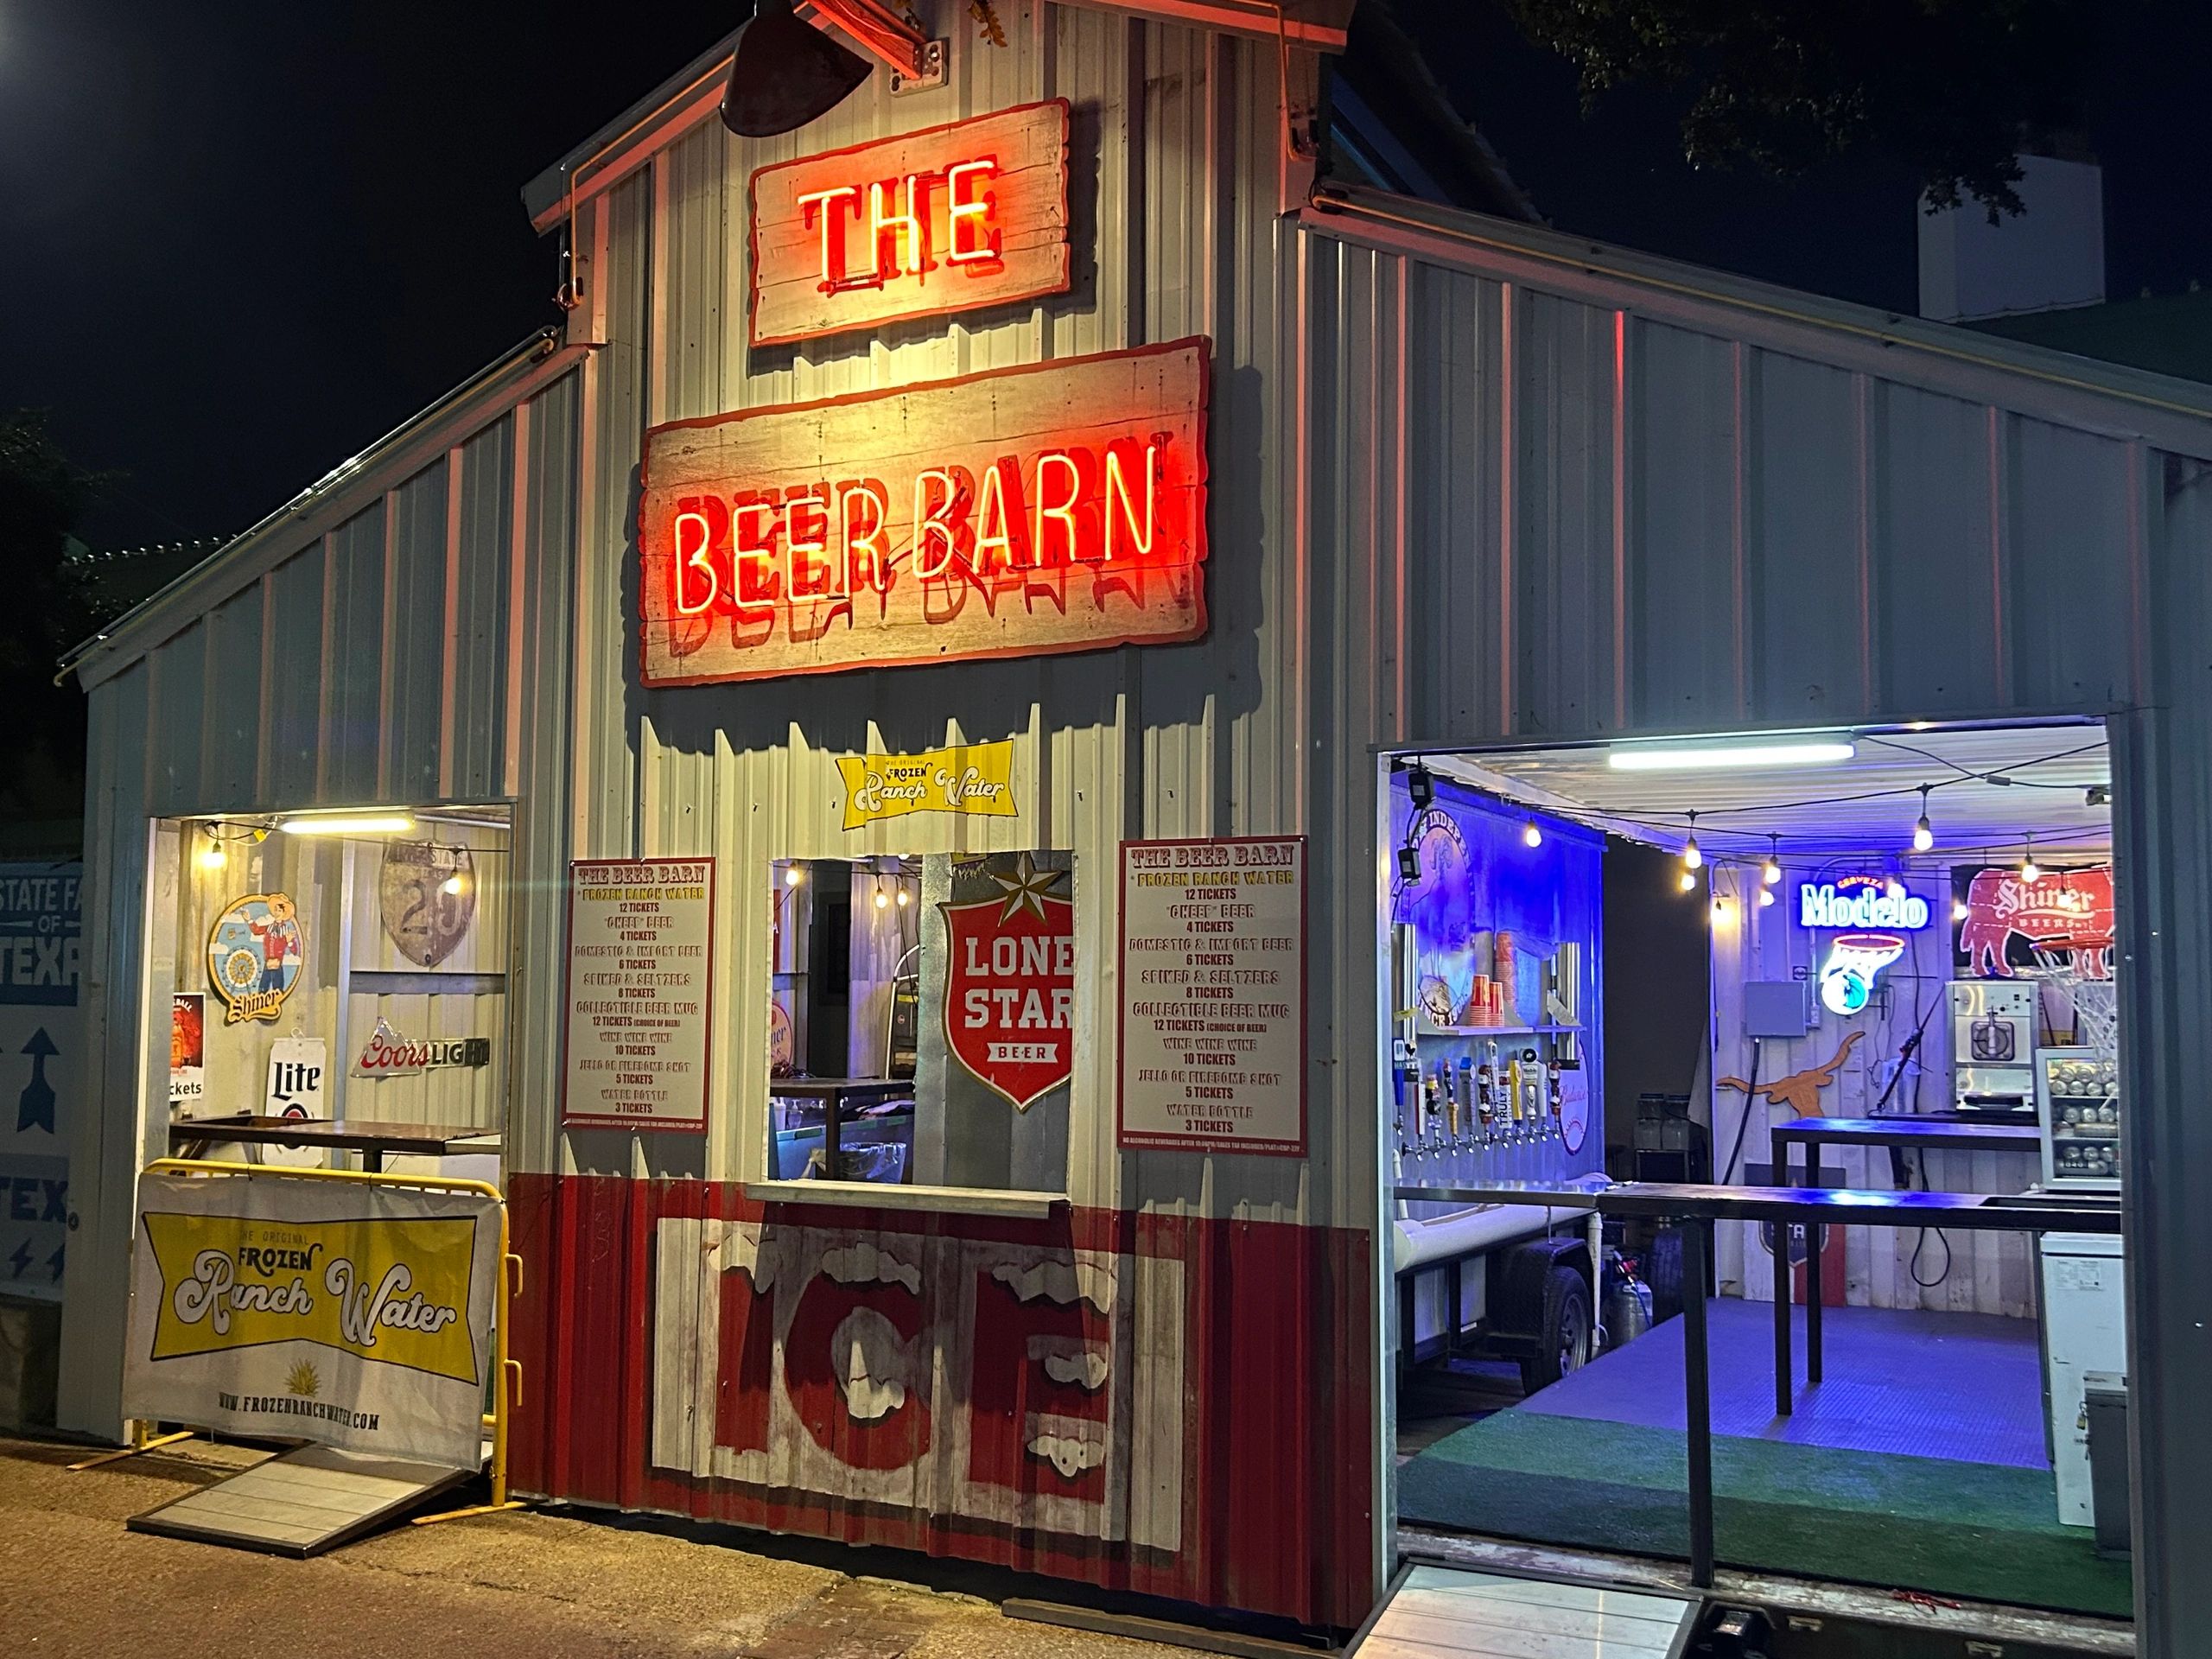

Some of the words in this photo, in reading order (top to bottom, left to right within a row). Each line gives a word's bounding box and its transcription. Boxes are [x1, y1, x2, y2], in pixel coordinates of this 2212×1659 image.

[798, 154, 1001, 283] THE
[671, 480, 888, 615] BEER
[911, 432, 1173, 579] BARN
[887, 761, 933, 782] FROZEN
[854, 770, 928, 812] Ranch
[934, 766, 1005, 806] Water
[1131, 849, 1170, 868] THE
[1175, 846, 1230, 868] BEER
[1234, 844, 1294, 866] BARN
[578, 868, 608, 885] THE
[612, 866, 655, 884] BEER
[658, 865, 705, 883] BARN
[1138, 873, 1189, 887] FROZEN
[1192, 871, 1240, 886] RANCH
[1243, 871, 1294, 885] WATER
[1837, 875, 1884, 889] CERVEZA
[582, 888, 622, 900] FROZEN
[626, 888, 662, 900] RANCH
[665, 887, 704, 899] WATER
[1185, 890, 1195, 900] 12
[1198, 888, 1236, 899] TICKETS
[1995, 879, 2095, 918] Shiner
[401, 876, 464, 937] 20
[619, 903, 627, 912] 12
[629, 902, 659, 912] TICKETS
[1221, 905, 1255, 918] BEER
[1801, 883, 1928, 929] Modelo
[38, 915, 60, 932] OF
[646, 916, 674, 928] BEER
[1186, 922, 1192, 933] 4
[1195, 921, 1234, 933] TICKETS
[620, 931, 625, 941] 4
[626, 931, 657, 941] TICKETS
[1129, 938, 1192, 950] DOMESTIC
[1195, 939, 1205, 950] &
[1210, 938, 1258, 950] IMPORT
[1262, 938, 1294, 950] BEER
[575, 945, 624, 957] DOMESTIC
[626, 946, 634, 957] &
[637, 945, 675, 957] IMPORT
[677, 945, 703, 957] BEER
[965, 936, 1073, 976] LONE
[619, 960, 624, 969] 6
[626, 959, 657, 969] TICKETS
[1186, 955, 1192, 966] 6
[1196, 954, 1234, 966] TICKETS
[584, 973, 622, 985] SPIKED
[625, 973, 634, 985] &
[637, 973, 691, 986] SELTZERS
[1141, 970, 1190, 983] SPIKED
[1194, 970, 1205, 983] &
[1210, 970, 1280, 985] SELTZERS
[619, 988, 624, 998] 8
[625, 988, 655, 998] TICKETS
[1186, 987, 1192, 999] 8
[1195, 987, 1234, 999] TICKETS
[232, 990, 280, 1021] Shiner
[576, 1001, 643, 1014] COLLECTIBLE
[645, 1001, 671, 1014] BEER
[674, 1001, 698, 1014] MUG
[964, 988, 1072, 1029] STAR
[1133, 1002, 1217, 1017] COLLECTIBLE
[1221, 1003, 1255, 1018] BEER
[1258, 1004, 1290, 1019] MUG
[593, 1016, 601, 1027] 12
[602, 1016, 632, 1027] TICKETS
[1154, 1020, 1164, 1030] 12
[1166, 1020, 1205, 1032] TICKETS
[1237, 1023, 1245, 1033] OF
[600, 1032, 622, 1042] WINE
[625, 1032, 646, 1042] WINE
[650, 1033, 672, 1043] WINE
[615, 1046, 624, 1055] 10
[626, 1046, 655, 1056] TICKETS
[1163, 1038, 1192, 1049] WINE
[1196, 1039, 1224, 1050] WINE
[1228, 1039, 1256, 1051] WINE
[360, 1034, 429, 1069] Coors
[431, 1039, 488, 1064] LIGHT
[998, 1046, 1046, 1059] BEER
[1184, 1053, 1194, 1065] 10
[1196, 1053, 1236, 1065] TICKETS
[605, 1061, 615, 1071] OR
[665, 1062, 691, 1073] SHOT
[271, 1062, 321, 1101] Lite
[616, 1074, 621, 1084] 5
[623, 1073, 653, 1084] TICKETS
[1139, 1070, 1166, 1082] JELLO
[1172, 1071, 1185, 1083] OR
[1189, 1071, 1246, 1084] FIREBOMB
[1249, 1073, 1281, 1085] SHOT
[601, 1089, 631, 1100] WATER
[634, 1090, 669, 1101] BOTTLE
[1185, 1087, 1192, 1097] 5
[1194, 1087, 1234, 1099] TICKETS
[615, 1103, 620, 1112] 3
[622, 1103, 652, 1113] TICKETS
[1166, 1104, 1206, 1116] WATER
[1210, 1104, 1253, 1118] BOTTLE
[1499, 1091, 1508, 1125] TRULY
[1185, 1120, 1192, 1131] 3
[1194, 1120, 1234, 1133] TICKETS
[263, 1231, 308, 1245] ORIGINAL
[238, 1243, 323, 1277] FROZEN
[175, 1249, 314, 1335] Ranch
[325, 1258, 458, 1347] Water
[709, 1233, 1118, 1505] ICE
